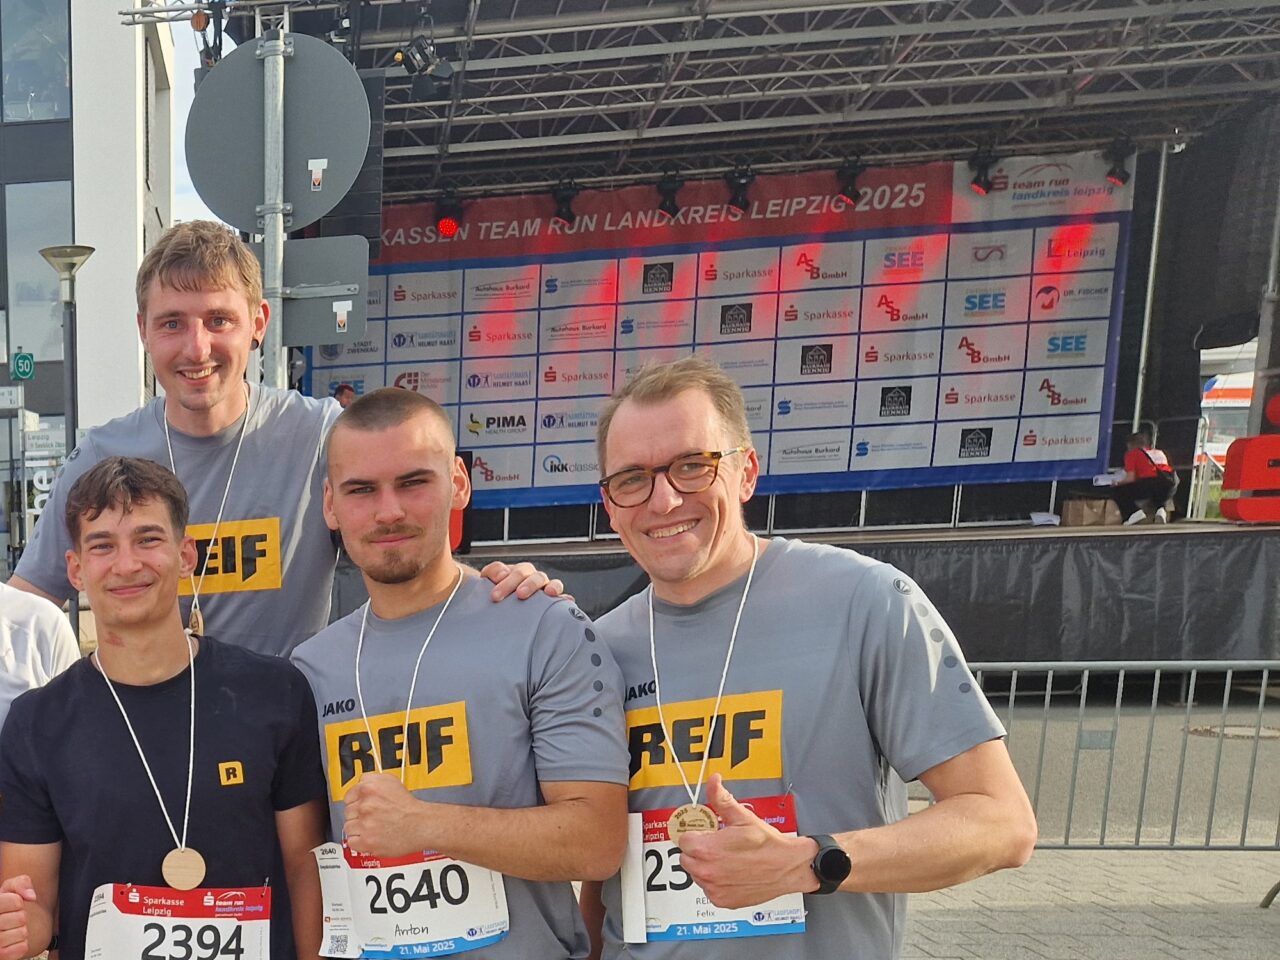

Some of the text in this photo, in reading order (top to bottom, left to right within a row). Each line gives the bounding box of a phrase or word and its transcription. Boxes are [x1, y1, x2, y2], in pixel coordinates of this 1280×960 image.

[1012, 177, 1070, 190] team run
[1011, 185, 1114, 201] landkreis leipzig
[478, 218, 541, 240] TEAM
[603, 204, 744, 232] LANDKREIS
[750, 194, 849, 220] LEIPZIG
[855, 182, 927, 213] 2025
[883, 251, 924, 269] SEE
[722, 268, 774, 281] Sparkasse
[410, 289, 458, 304] Sparkasse
[964, 293, 1006, 311] SEE
[803, 309, 854, 321] Sparkasse
[485, 331, 533, 342] Sparkasse
[1047, 335, 1087, 353] SEE
[883, 352, 935, 363] Sparkasse
[18, 360, 30, 372] 50
[561, 370, 609, 382] Sparkasse
[964, 393, 1016, 404] Sparkasse
[485, 415, 527, 429] PIMA
[1041, 436, 1092, 446] Sparkasse
[322, 698, 356, 718] JAKO
[628, 709, 767, 780] REIF
[338, 716, 454, 788] REIF
[225, 766, 238, 782] R
[360, 859, 381, 868] Leipzig
[645, 847, 694, 892] 23
[365, 863, 470, 914] 2640
[143, 896, 185, 907] Sparkasse
[142, 906, 172, 917] Leipzig
[394, 923, 429, 937] Anton
[676, 923, 738, 935] 21. Mai 2025
[399, 940, 455, 954] 21. Mai 2025
